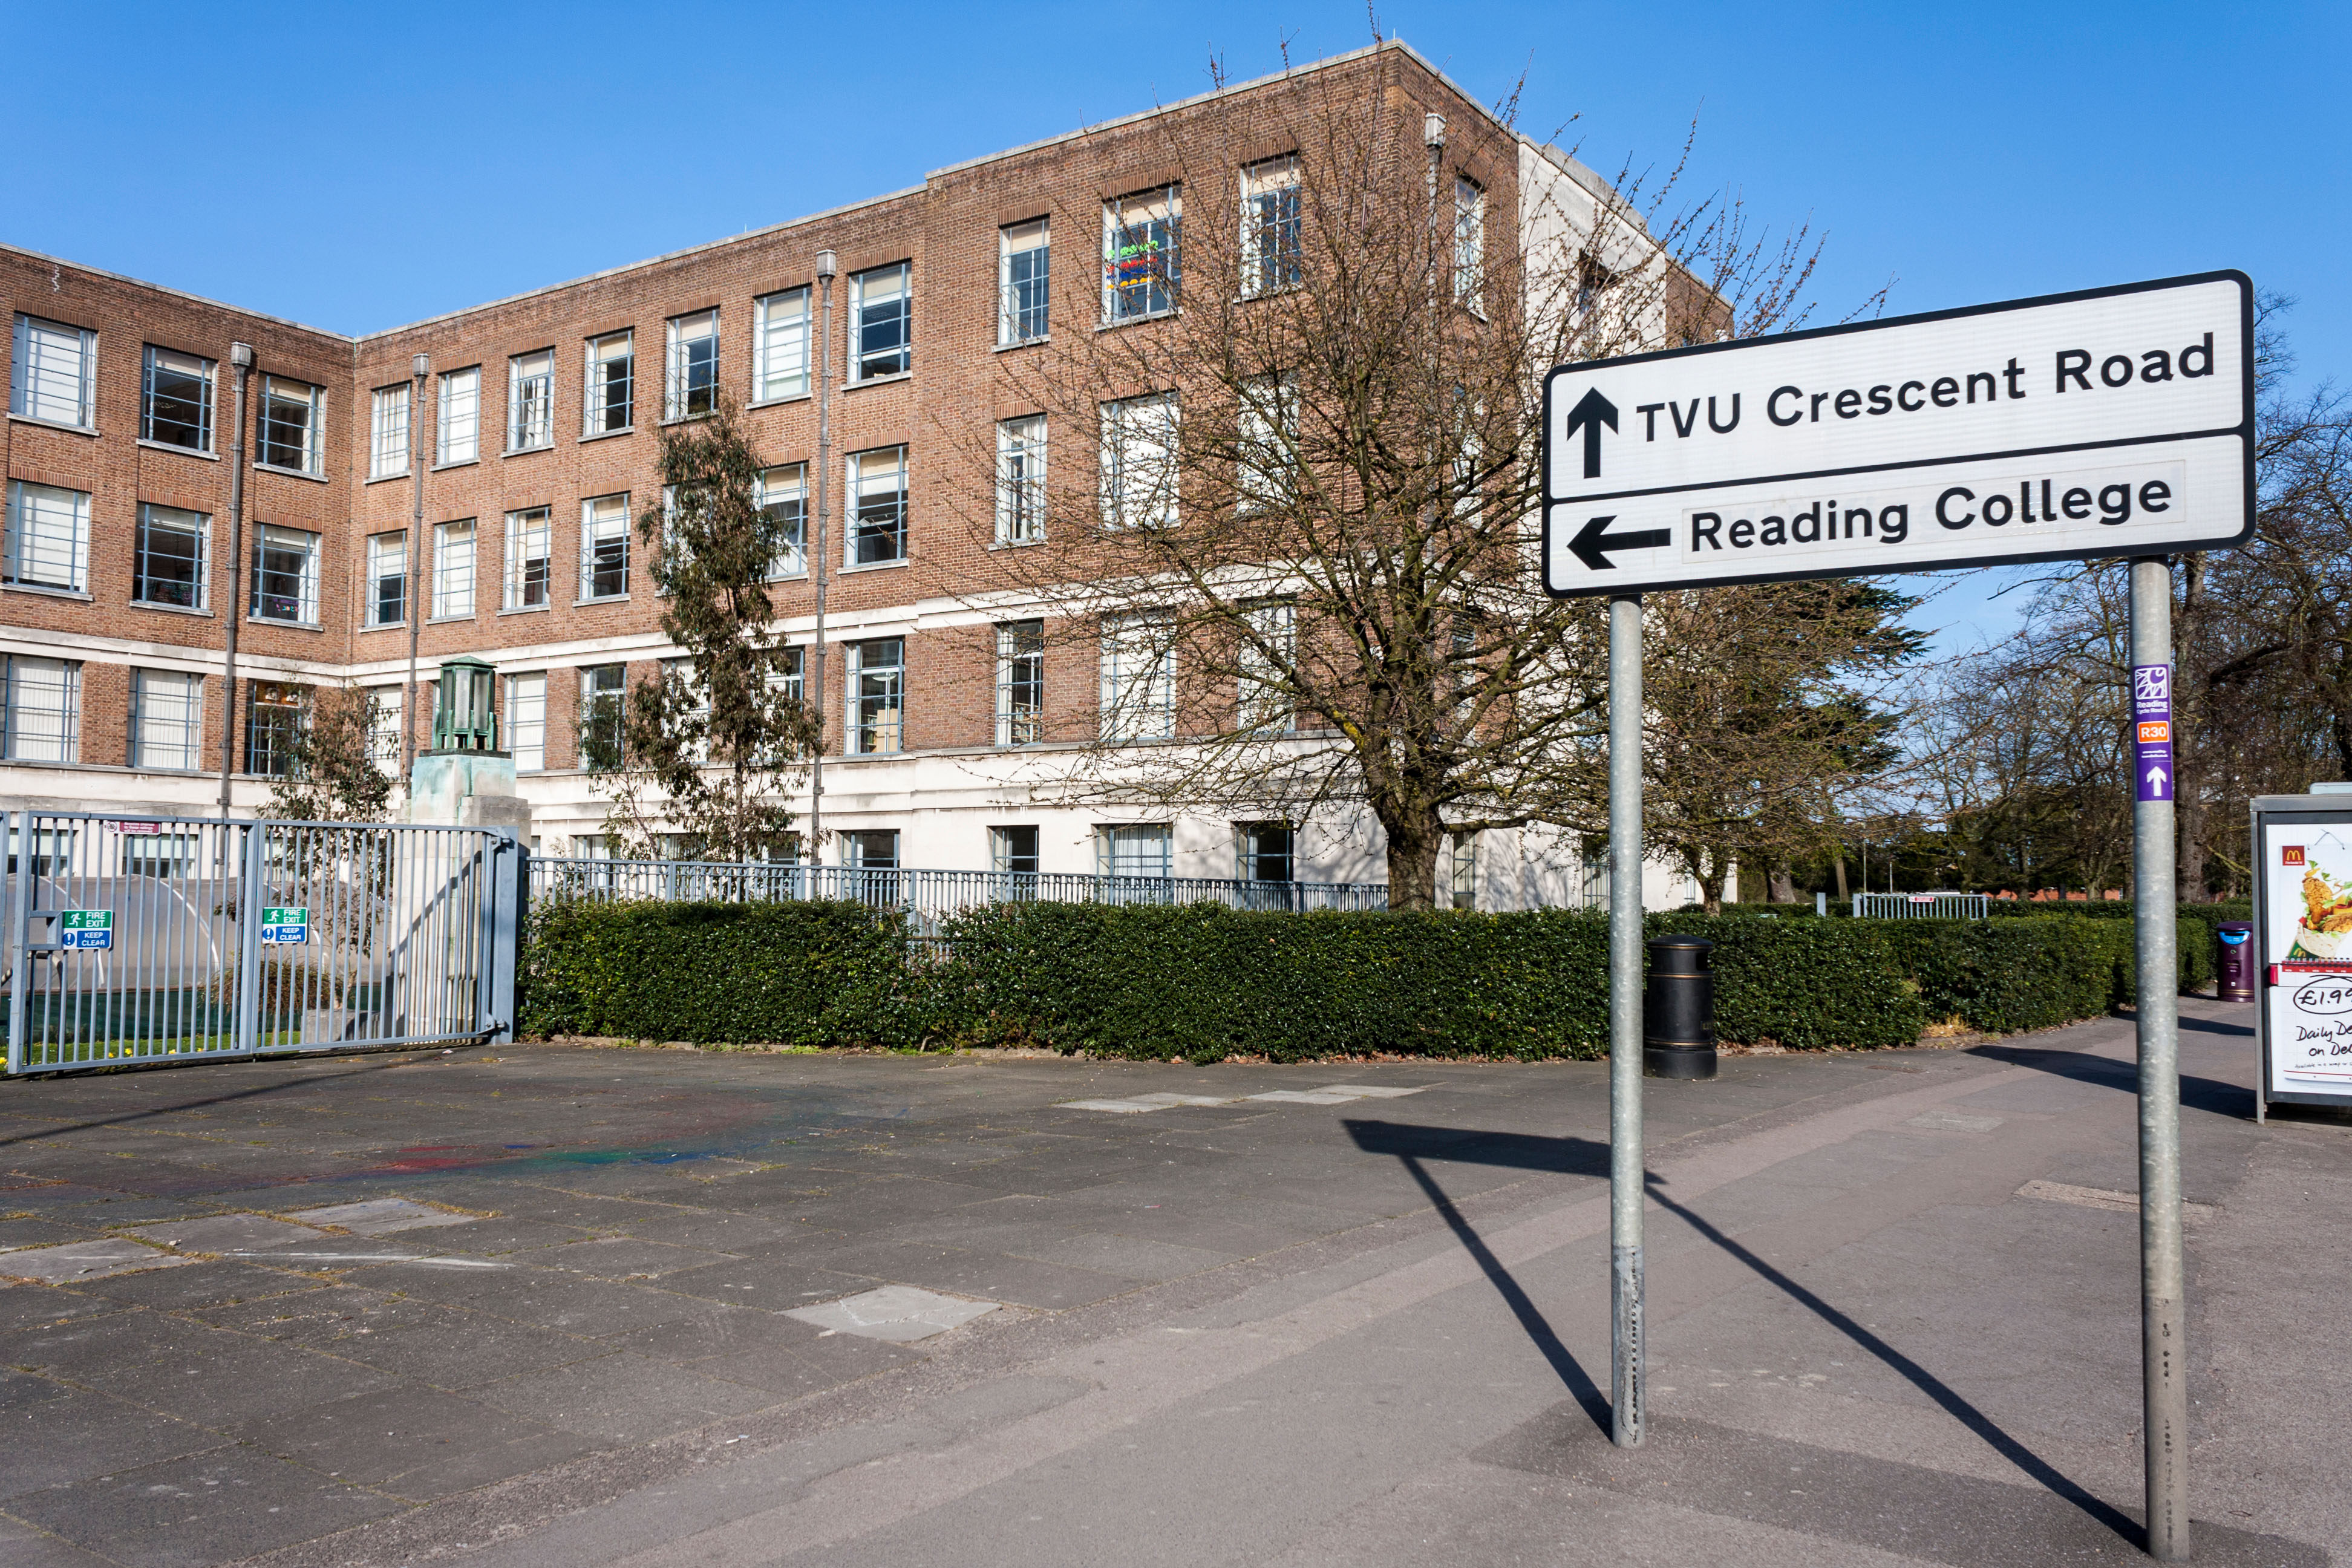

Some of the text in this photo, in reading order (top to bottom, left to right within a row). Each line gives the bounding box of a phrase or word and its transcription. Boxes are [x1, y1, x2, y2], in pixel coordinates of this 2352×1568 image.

[1637, 332, 2213, 442] TVU Crescent Road
[1693, 479, 2171, 552] Reading College
[2137, 700, 2167, 708] Reading
[2141, 727, 2167, 739] R30
[2296, 1025, 2333, 1042] Daily
[2308, 1048, 2325, 1056] on
